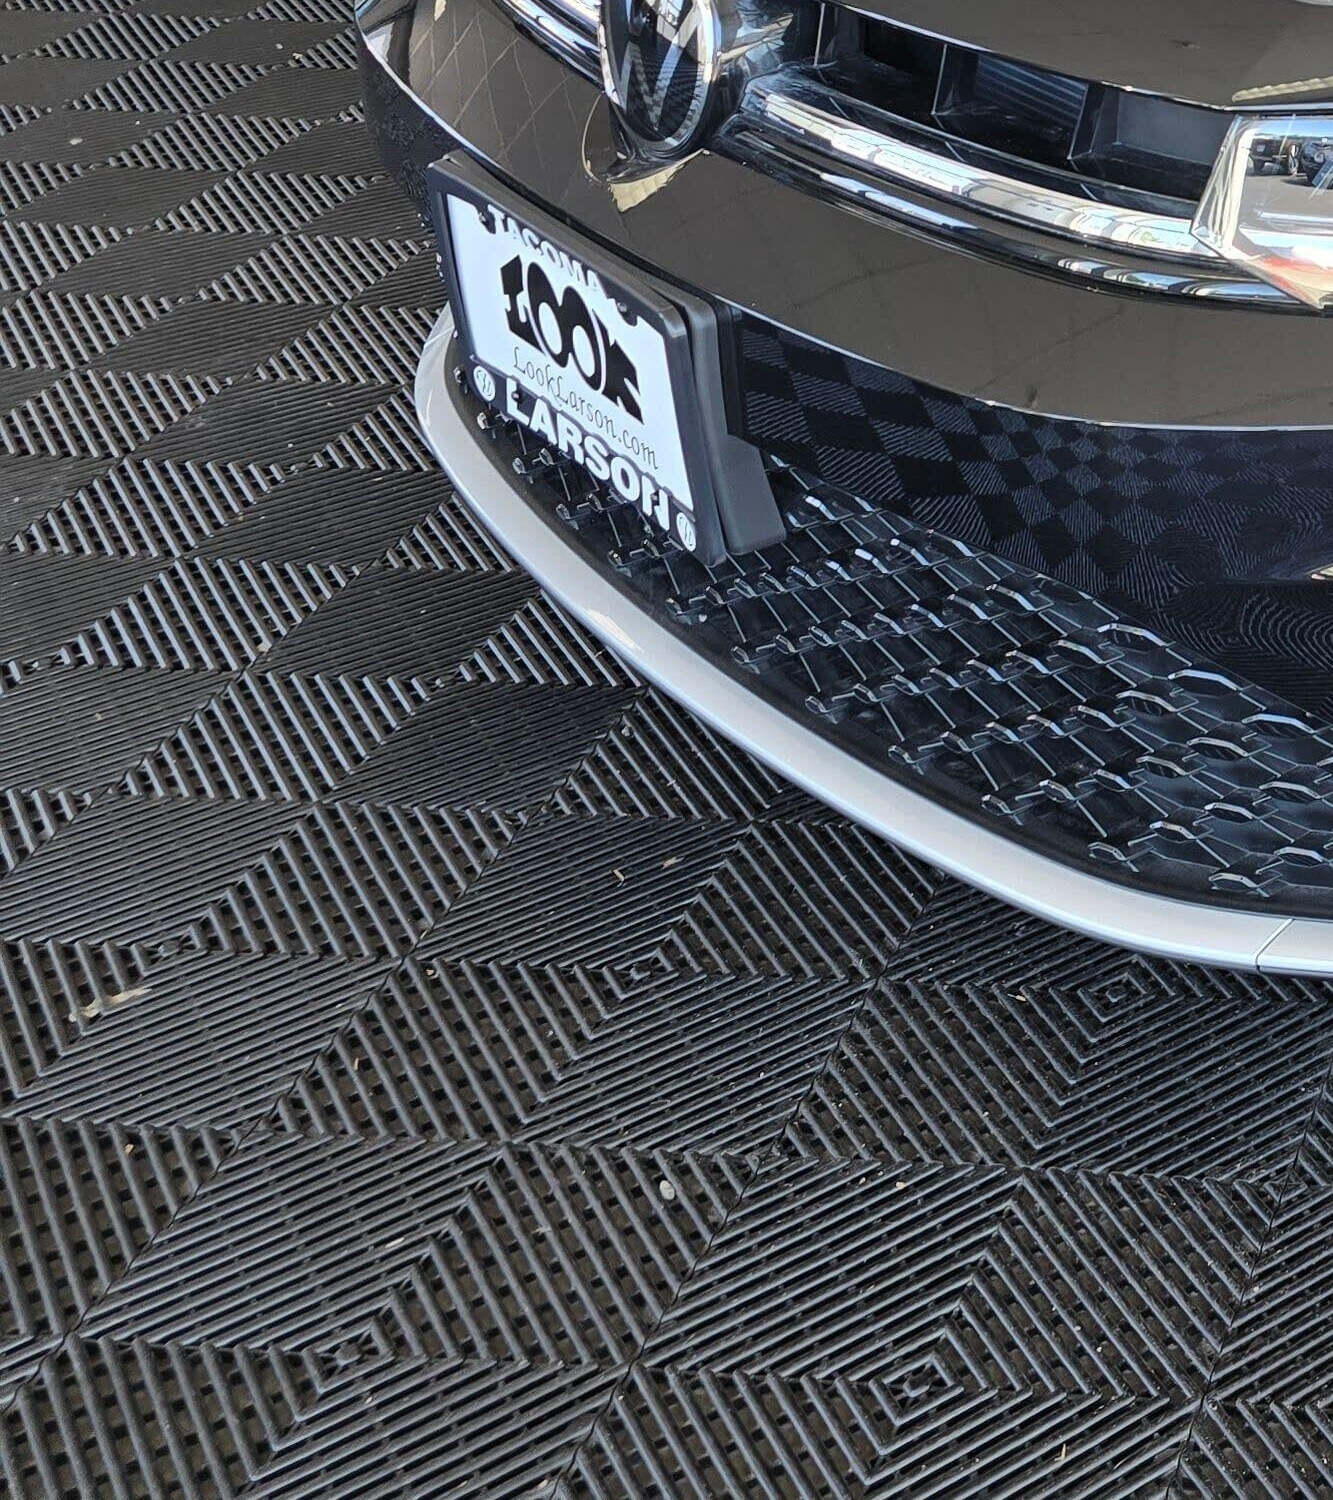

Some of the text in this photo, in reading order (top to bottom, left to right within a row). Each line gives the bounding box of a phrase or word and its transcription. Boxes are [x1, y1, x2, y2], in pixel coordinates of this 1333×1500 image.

[487, 204, 602, 293] TACOMA
[506, 377, 671, 531] LARSON
[513, 346, 660, 470] LookLarson.com
